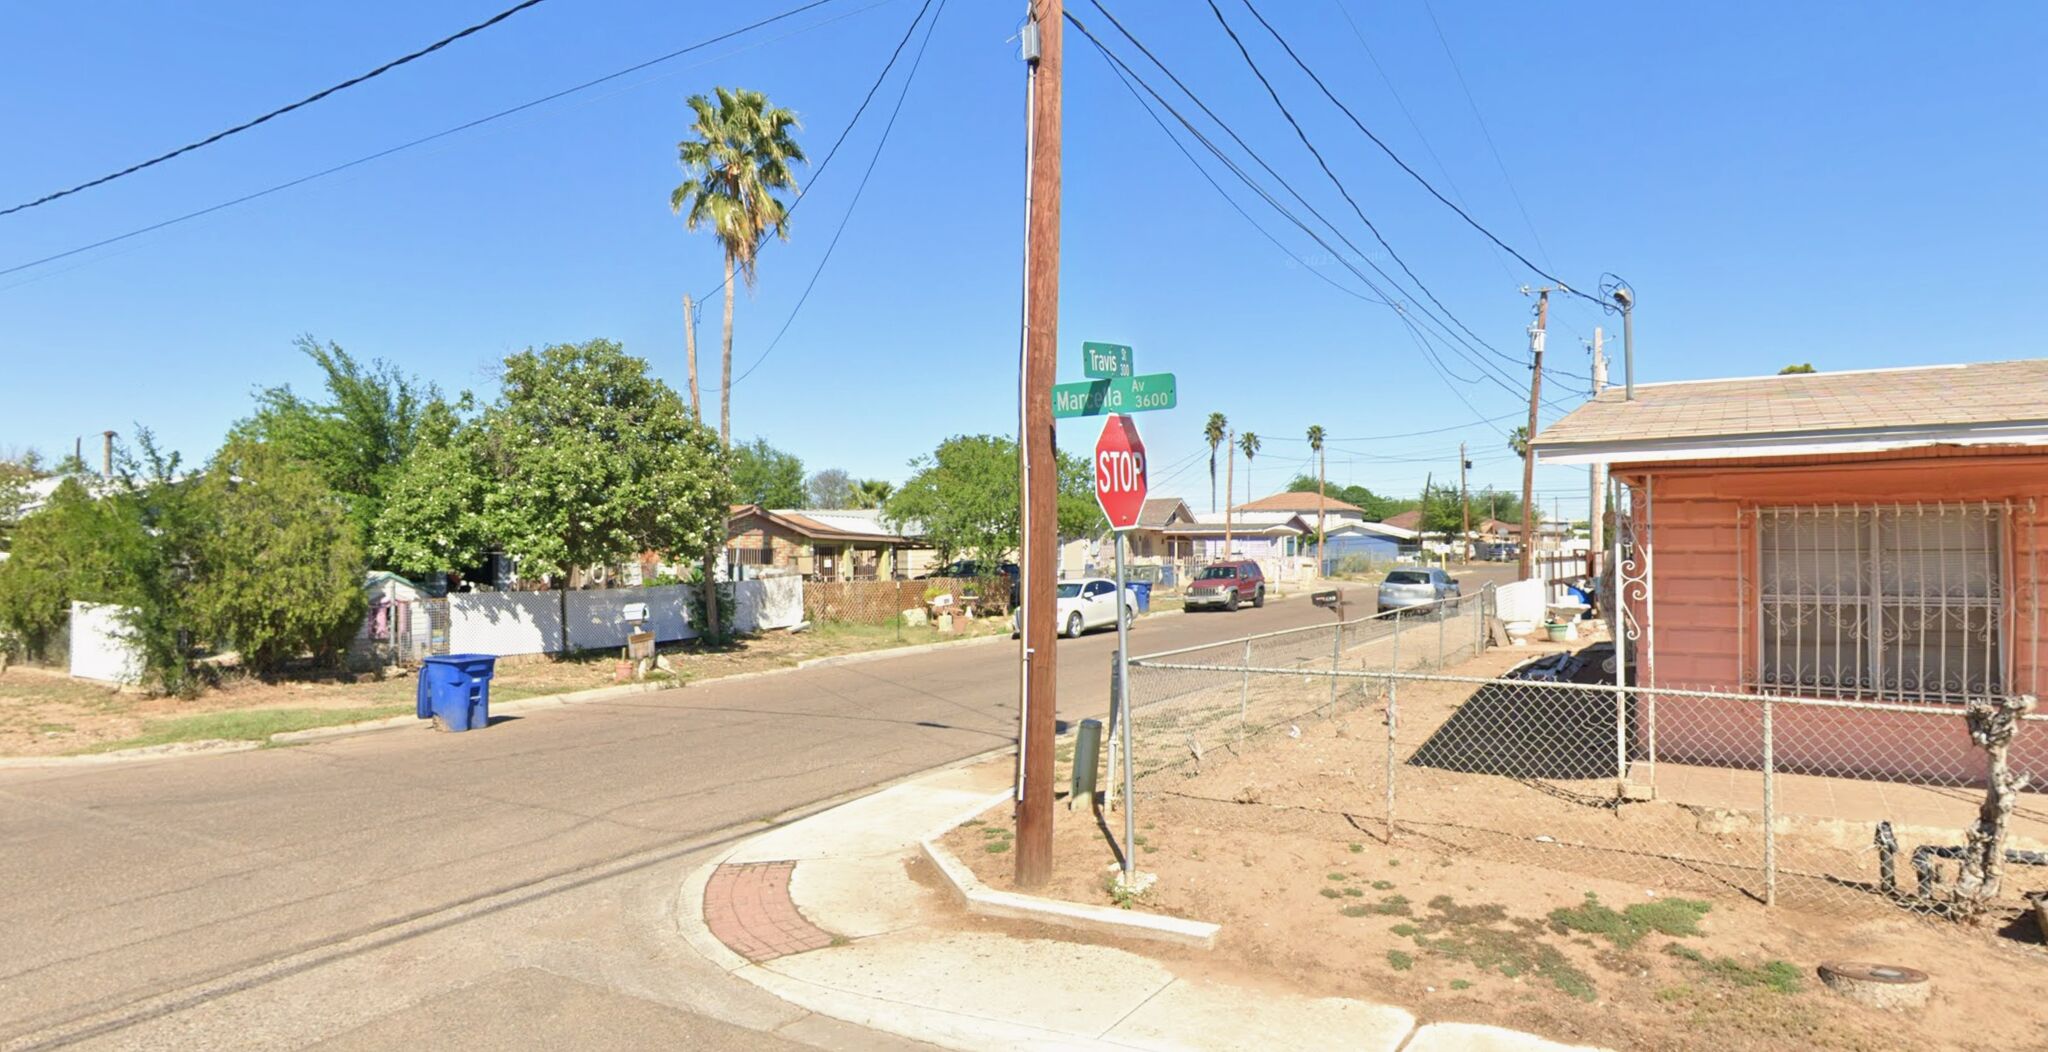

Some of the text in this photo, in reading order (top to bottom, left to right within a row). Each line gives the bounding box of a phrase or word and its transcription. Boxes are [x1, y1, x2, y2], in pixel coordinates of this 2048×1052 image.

[1088, 349, 1117, 371] Travis
[1131, 379, 1145, 393] Av
[1056, 386, 1122, 411] Marcella
[1135, 392, 1168, 408] 3600
[1099, 450, 1144, 494] STOP
